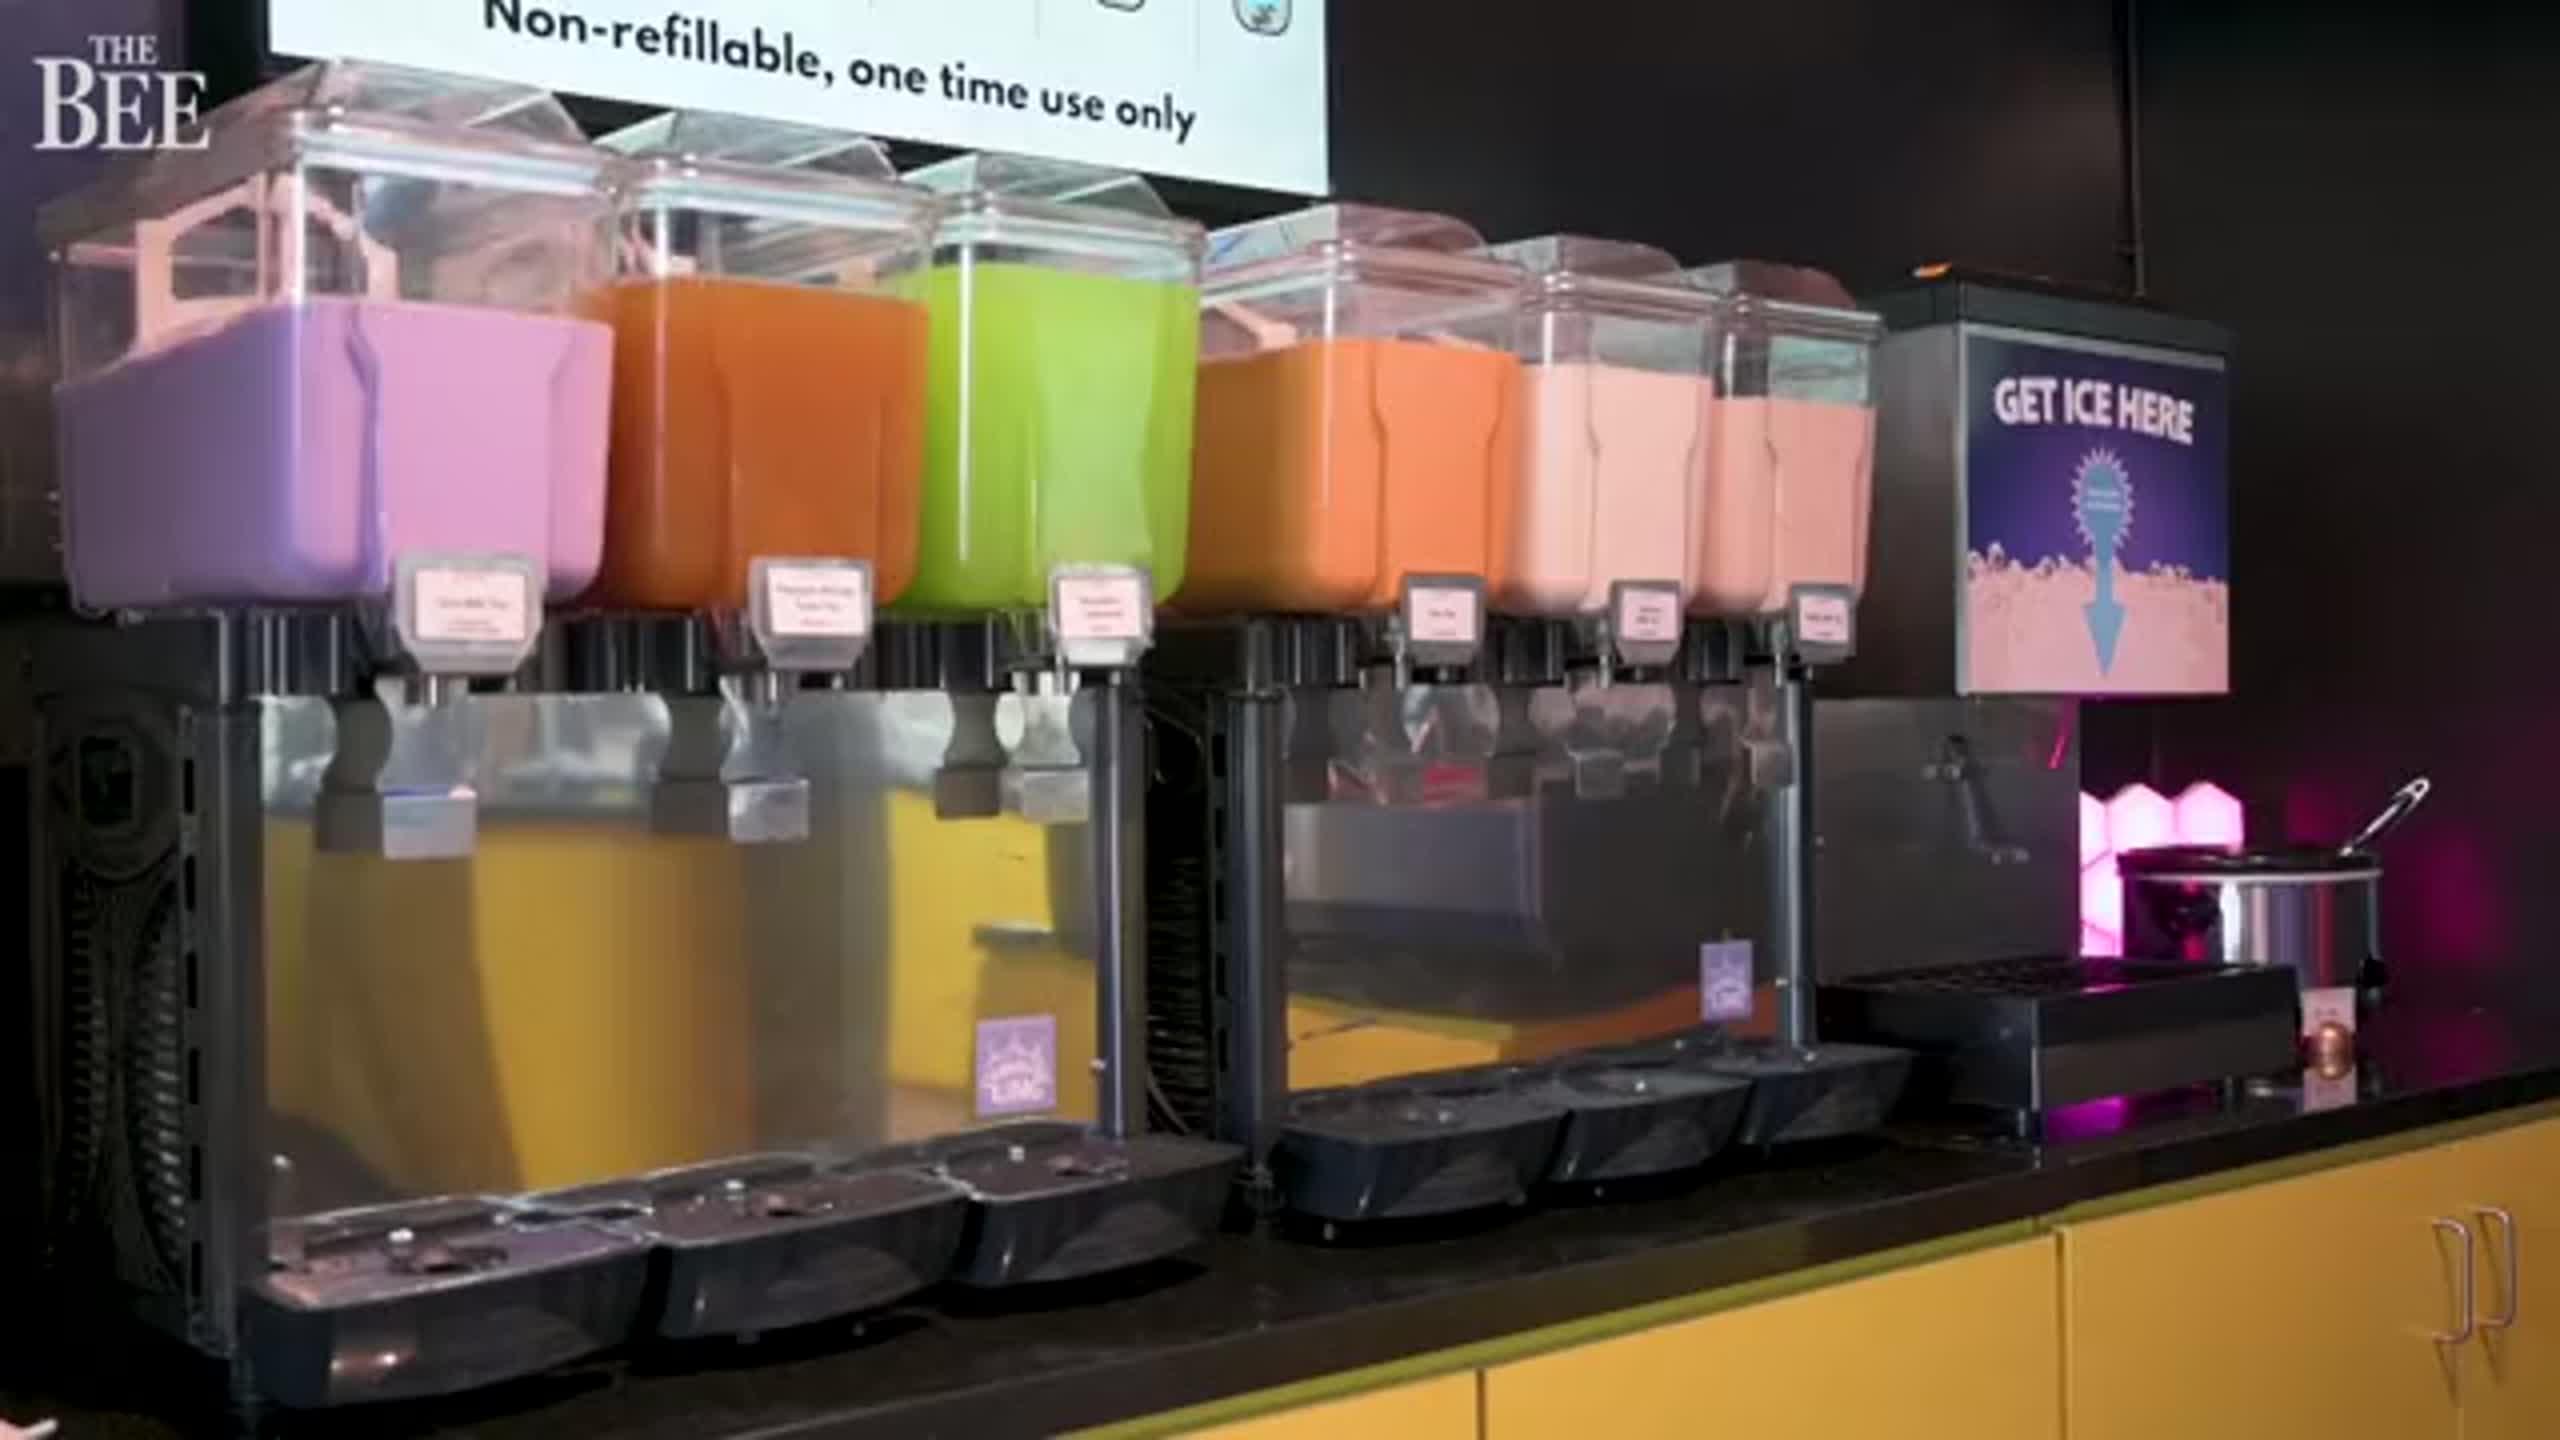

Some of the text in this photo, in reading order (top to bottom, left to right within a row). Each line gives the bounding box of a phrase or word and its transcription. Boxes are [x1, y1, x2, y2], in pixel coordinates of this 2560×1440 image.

[484, 0, 1196, 145] Non-refillable, one time use only
[1994, 376, 2195, 446] GET ICE HERE
